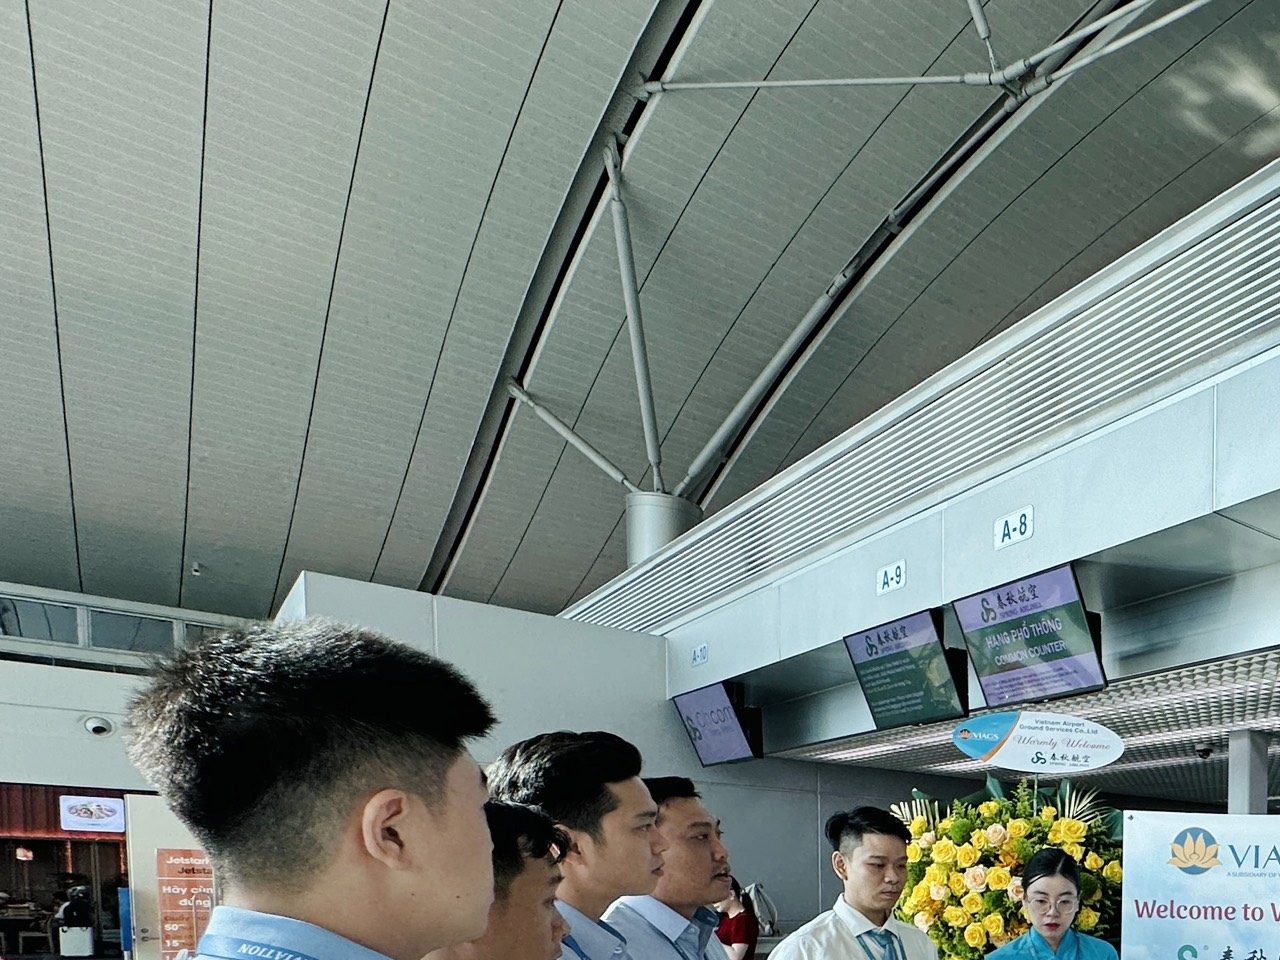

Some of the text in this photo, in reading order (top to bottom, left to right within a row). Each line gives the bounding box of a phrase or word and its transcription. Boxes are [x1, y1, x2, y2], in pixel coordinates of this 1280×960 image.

[1001, 513, 1027, 543] A-8
[881, 565, 901, 590] A-9
[985, 617, 1062, 650] HẠNG PHỔ THÔNG
[692, 645, 707, 664] A-10
[994, 640, 1066, 666] COMMON COUNTER
[1044, 725, 1073, 733] Services
[1062, 720, 1085, 728] Airport
[972, 732, 999, 740] VIAGS
[1012, 735, 1111, 750] Warmly Welcome
[177, 867, 213, 875] Jetsta
[162, 886, 214, 895] Hãy cùn
[1133, 899, 1237, 922] Welcome
[1242, 902, 1264, 922] to
